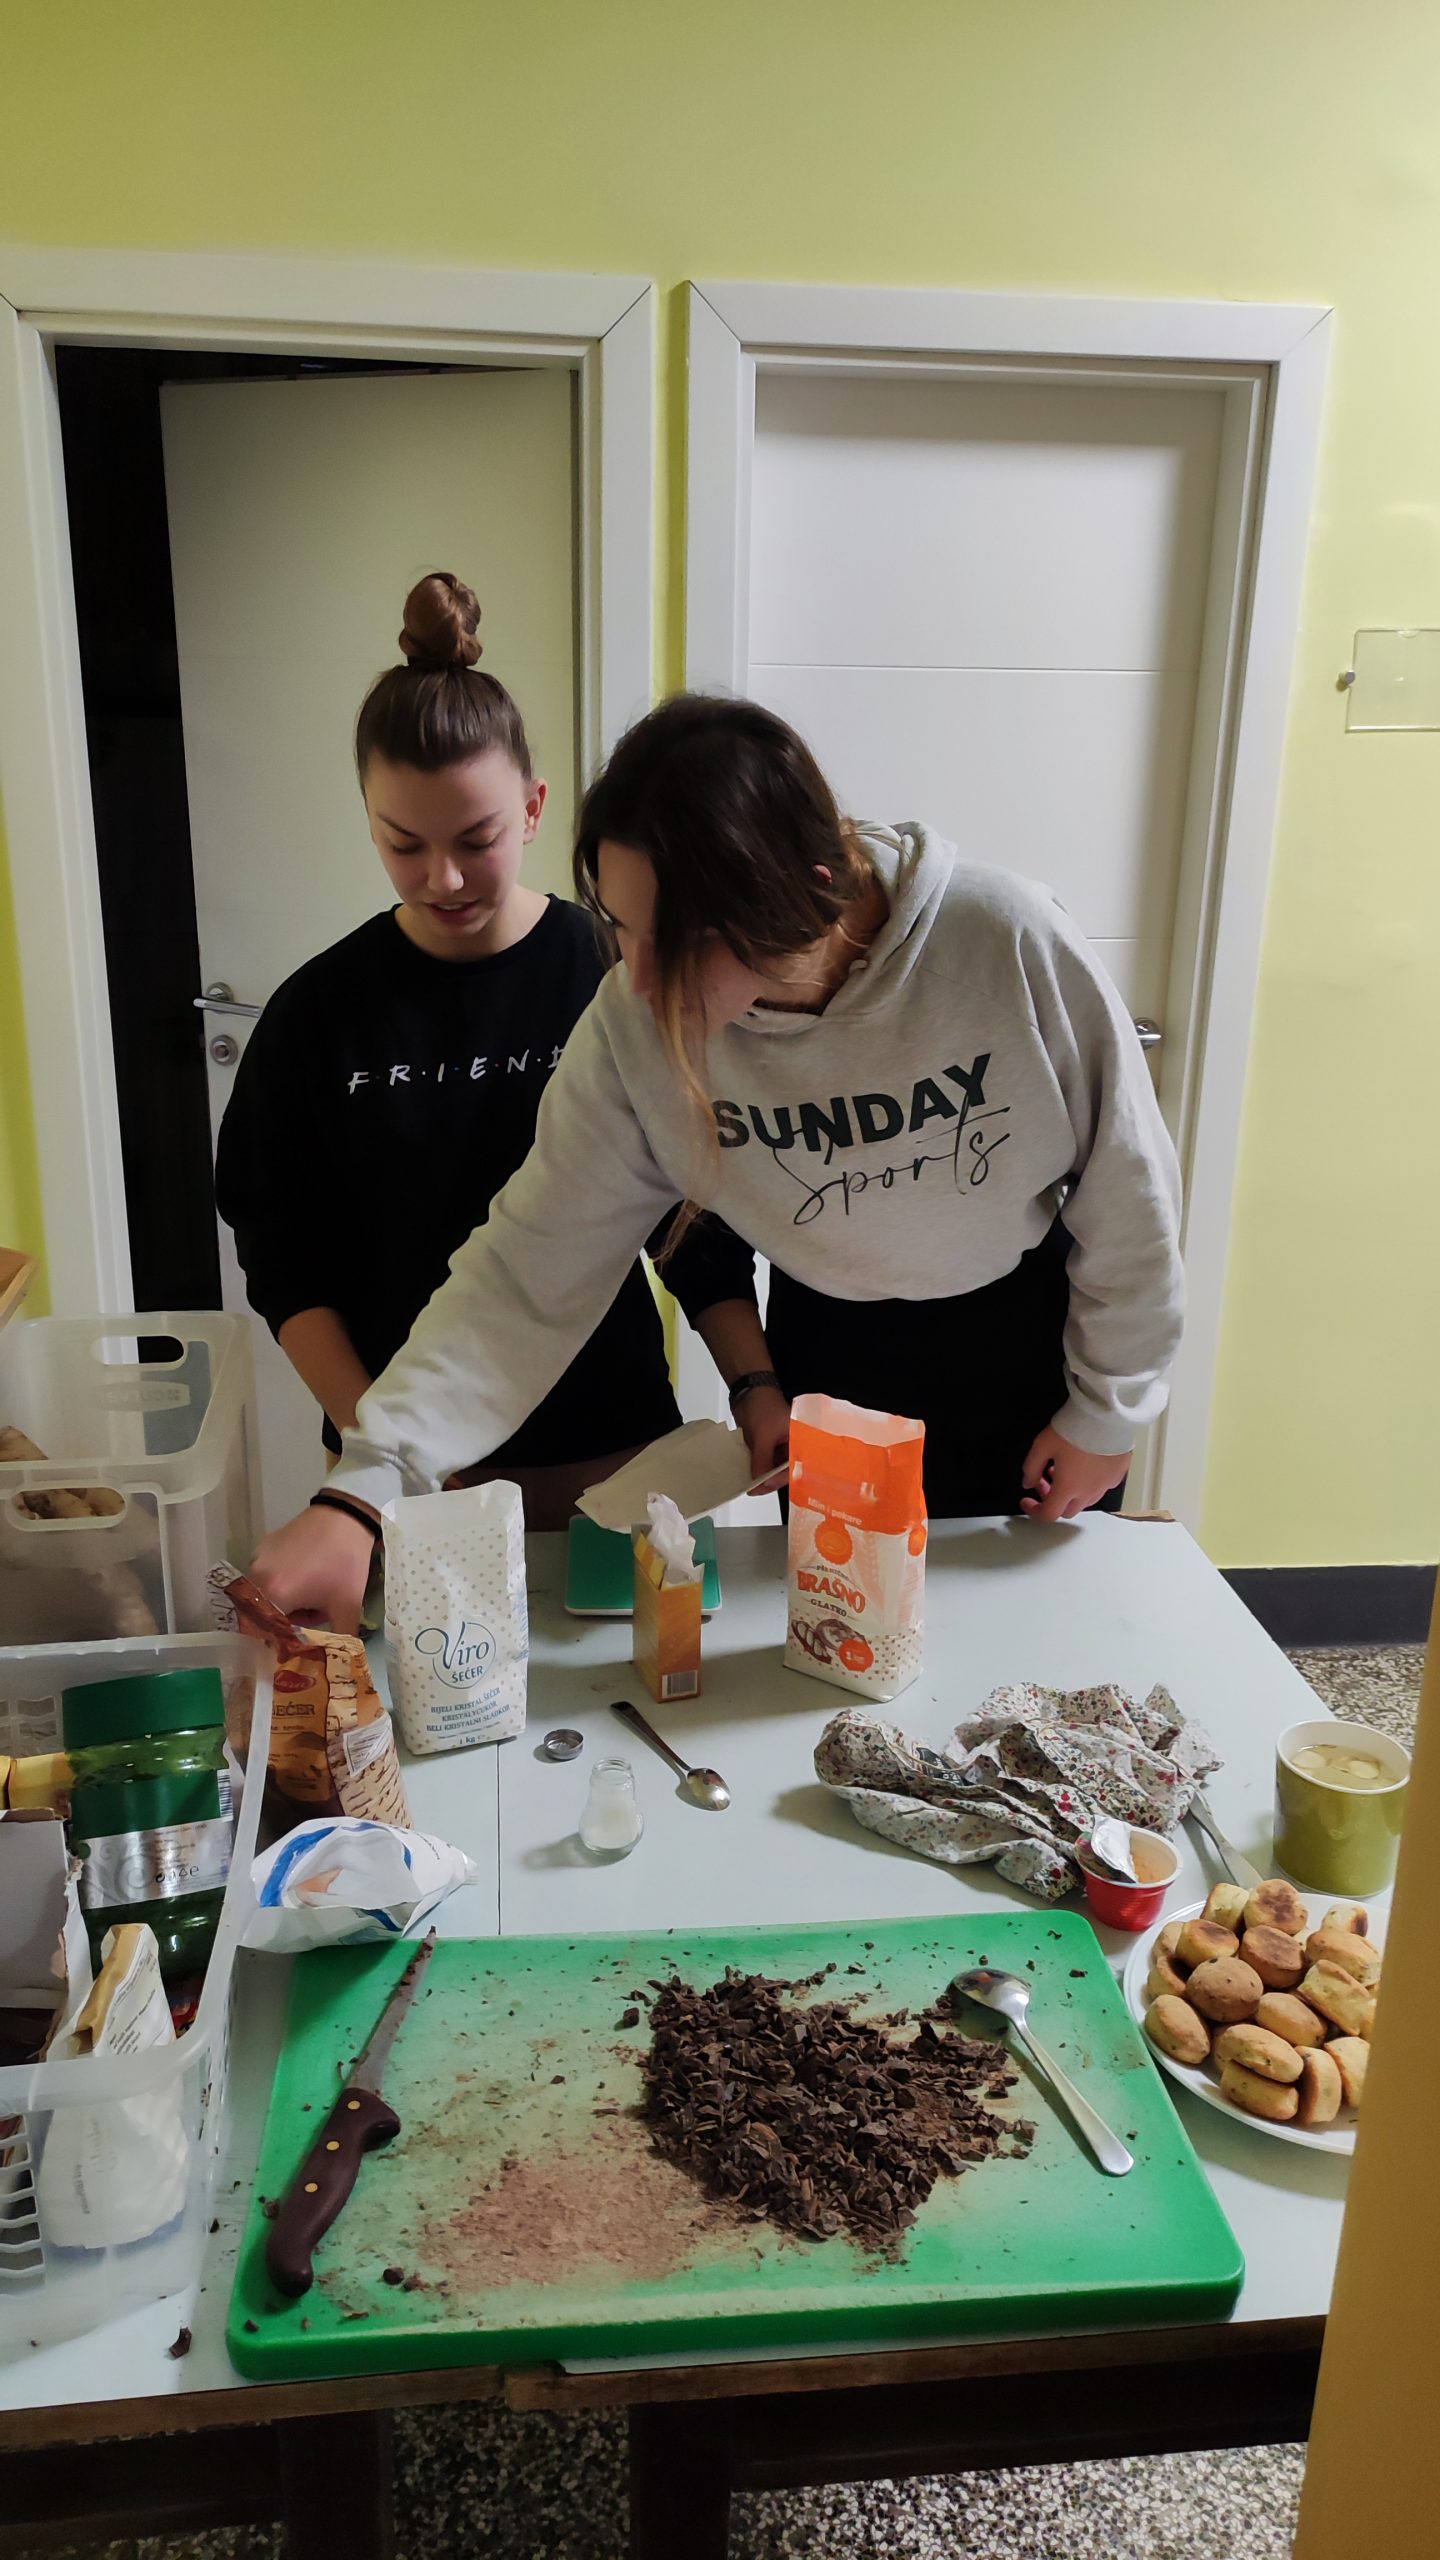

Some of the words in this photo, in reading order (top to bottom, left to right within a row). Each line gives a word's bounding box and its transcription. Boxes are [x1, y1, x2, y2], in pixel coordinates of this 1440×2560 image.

[711, 1052, 992, 1151] SUNDAY
[797, 1568, 866, 1614] BRAŠNO
[810, 1597, 847, 1618] GLATKO
[415, 1621, 490, 1670] Viro
[451, 1665, 484, 1684] ŠEČER
